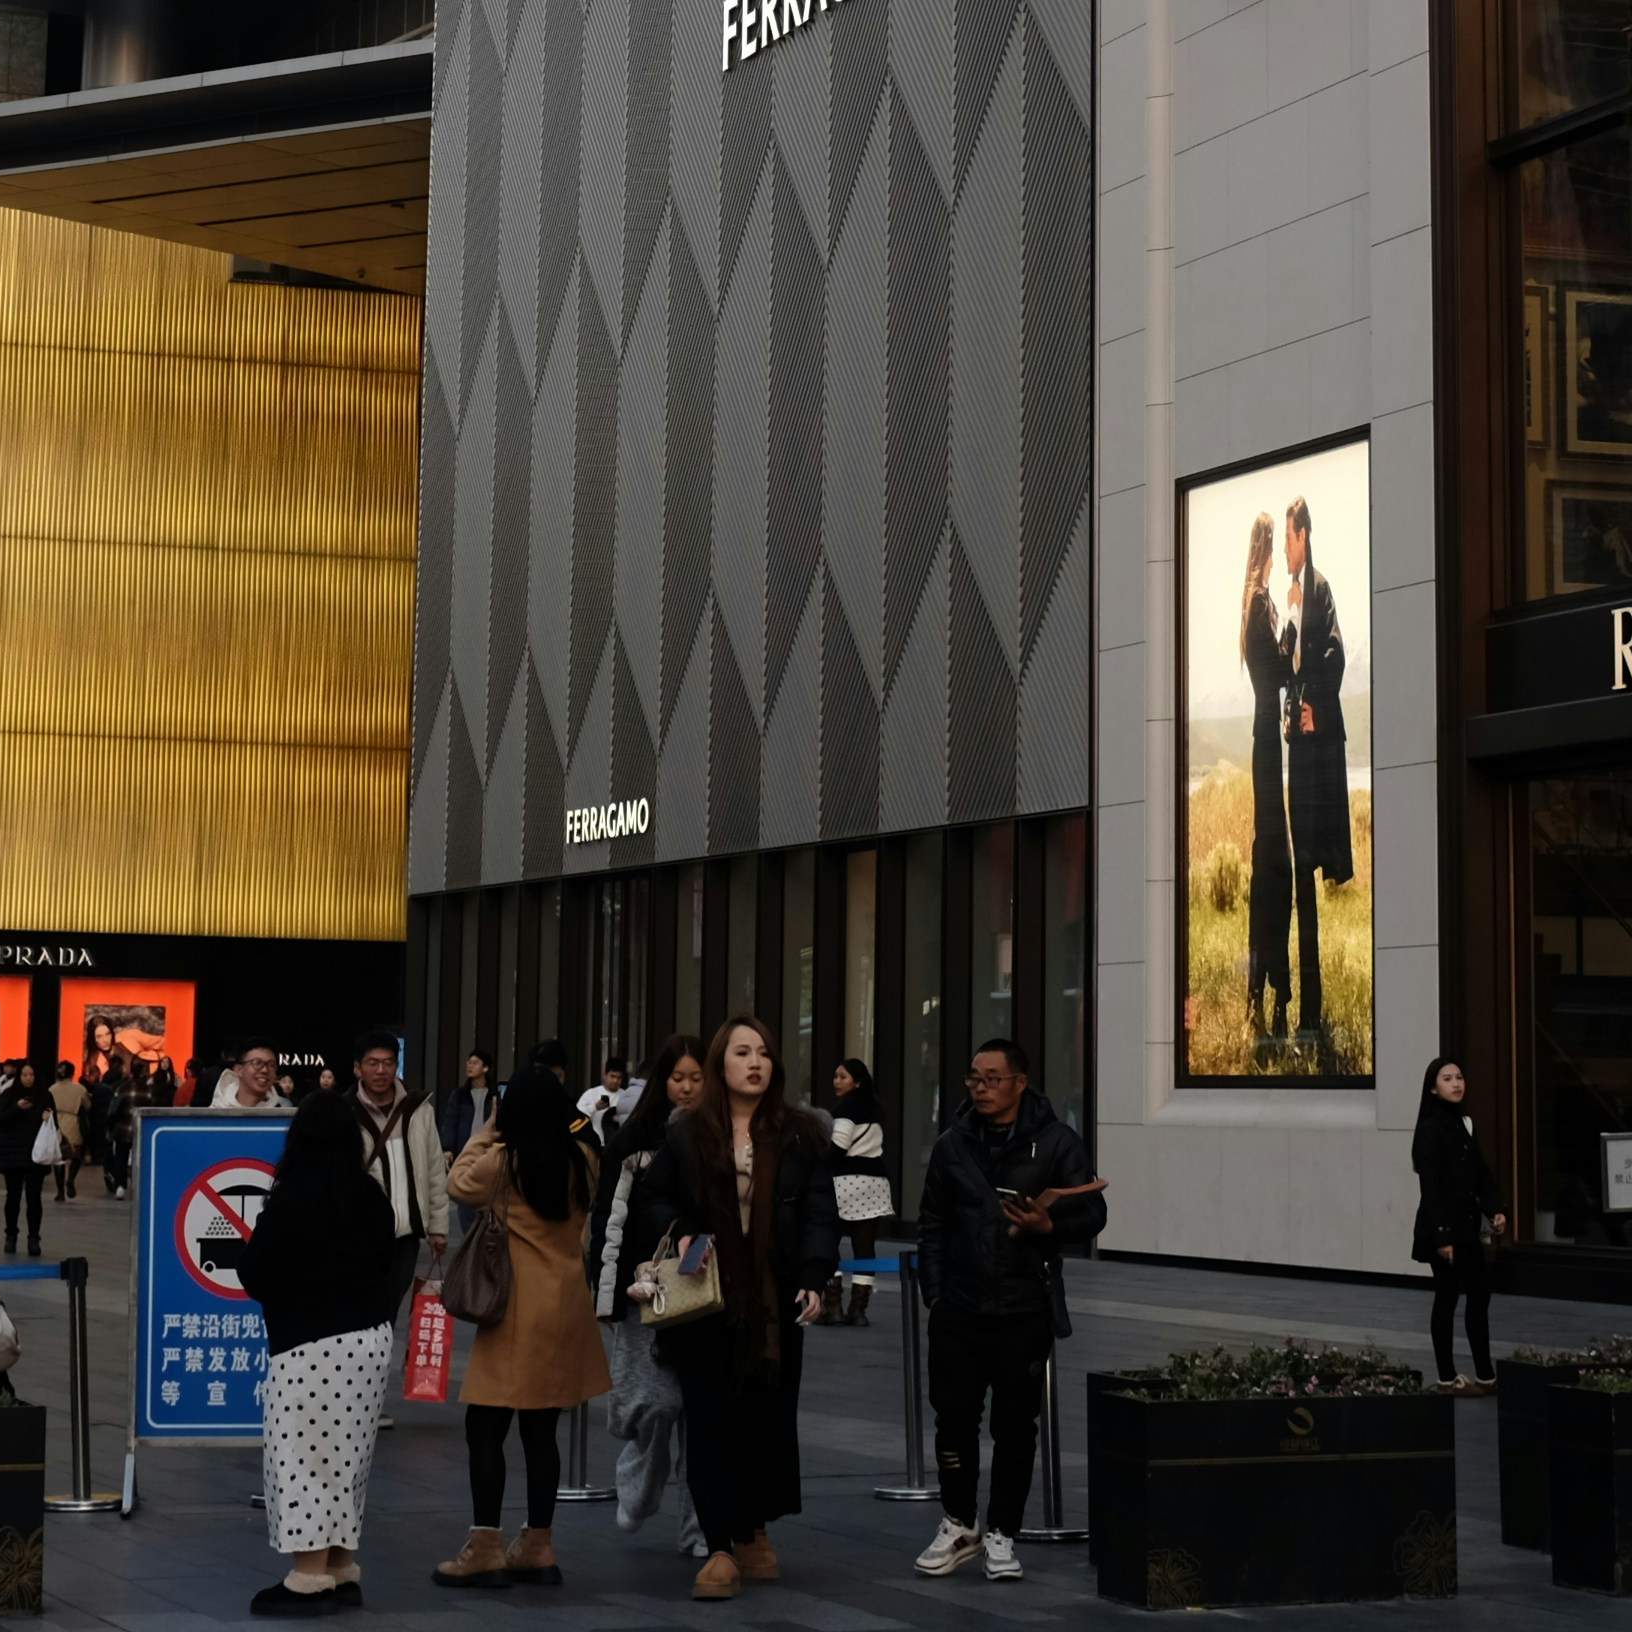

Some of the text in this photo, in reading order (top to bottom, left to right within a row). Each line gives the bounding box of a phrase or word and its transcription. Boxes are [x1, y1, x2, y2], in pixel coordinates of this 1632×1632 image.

[565, 797, 649, 845] FERRAGAMO
[278, 1052, 325, 1067] RADA
[161, 1312, 269, 1340] 严禁沿街兜
